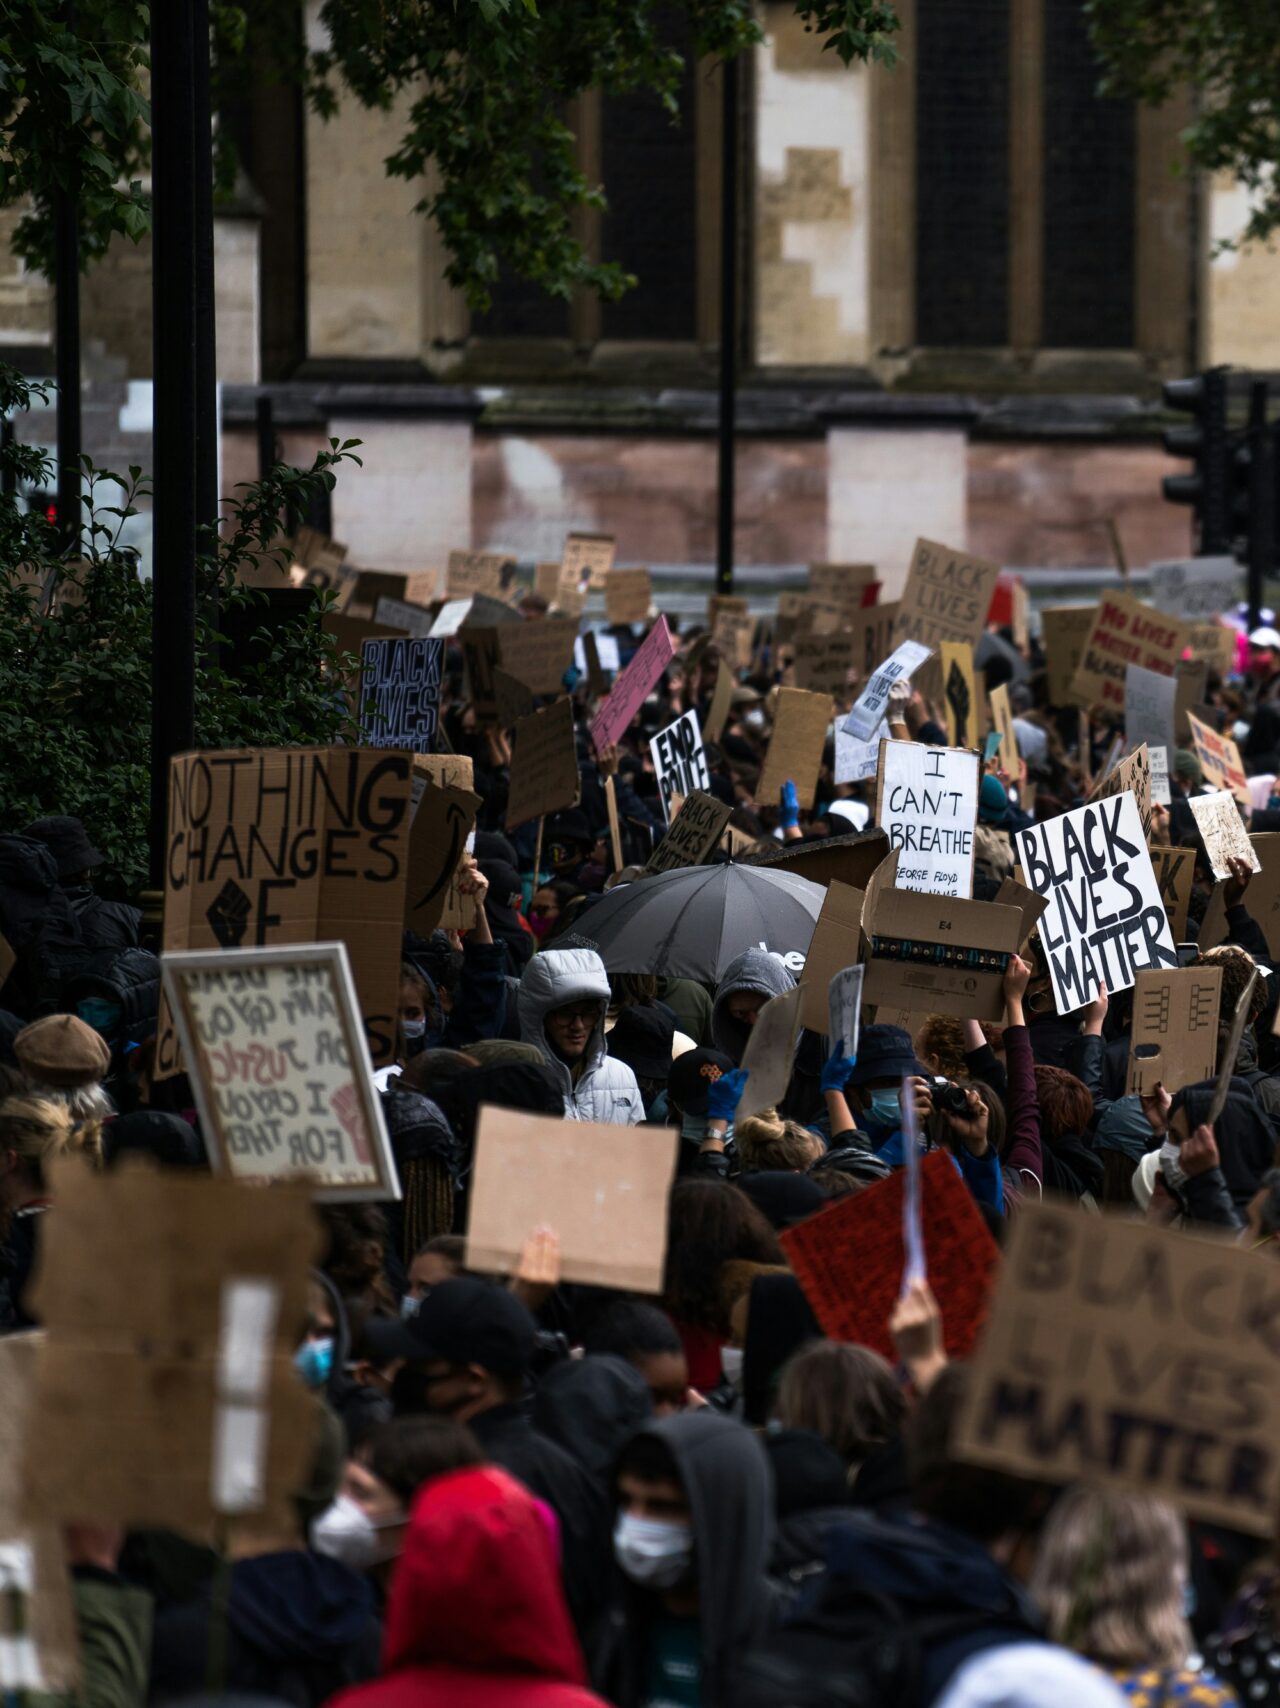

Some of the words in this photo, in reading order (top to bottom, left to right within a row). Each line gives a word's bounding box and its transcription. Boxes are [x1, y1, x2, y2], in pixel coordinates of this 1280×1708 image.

[916, 549, 988, 590] BLACK
[917, 583, 979, 621] LIVES
[1130, 614, 1178, 649] LIVES
[362, 639, 441, 686] BLACK
[872, 676, 893, 697] LIVES
[360, 684, 438, 738] LIVES
[656, 716, 695, 773] END
[925, 752, 945, 777] I
[171, 752, 409, 834] NOTHING
[680, 796, 721, 830] BLACK
[889, 786, 962, 816] CAN'T
[669, 821, 708, 851] LIVES
[890, 823, 972, 855] BREATHE
[1021, 797, 1140, 895] BLACK
[169, 823, 400, 891] CHANGES
[934, 871, 958, 885] FLOYD
[938, 920, 952, 931] E4
[1041, 862, 1143, 951] LIVES
[1051, 905, 1179, 1011] MATTER
[1008, 1312, 1268, 1429] LIVES
[977, 1378, 1270, 1508] MATTER
